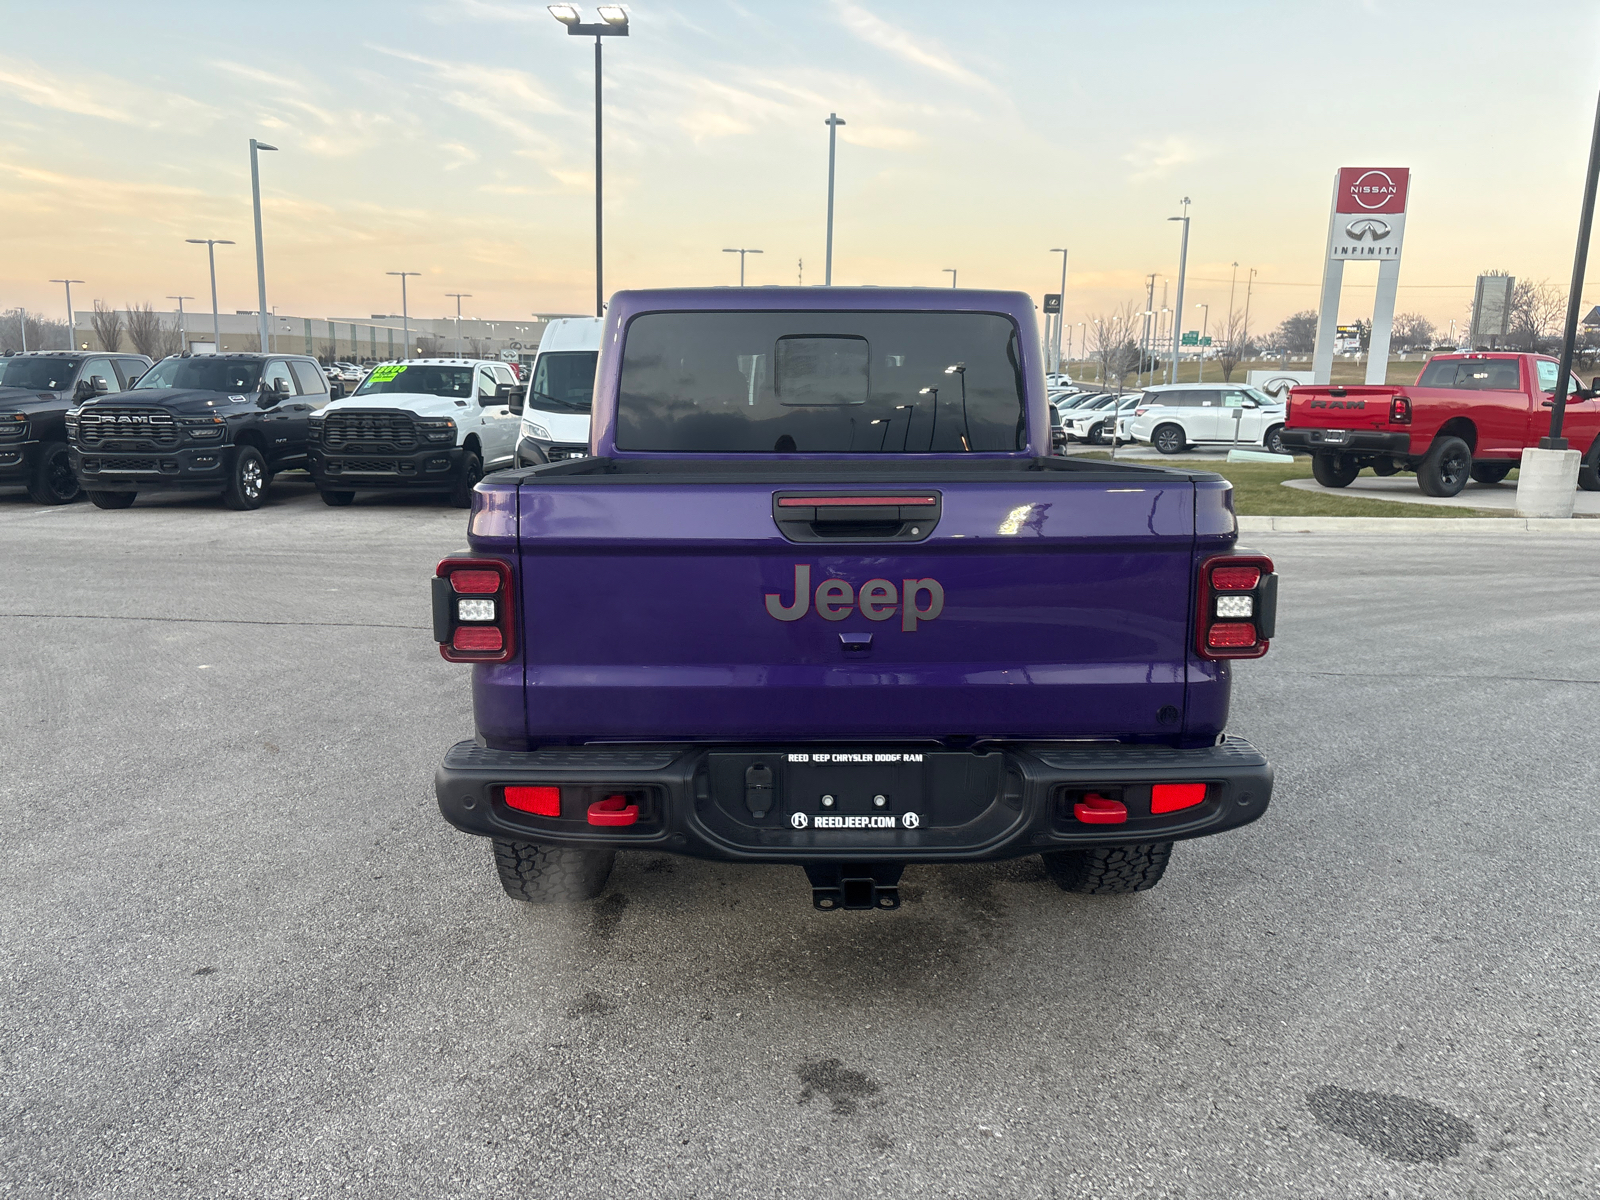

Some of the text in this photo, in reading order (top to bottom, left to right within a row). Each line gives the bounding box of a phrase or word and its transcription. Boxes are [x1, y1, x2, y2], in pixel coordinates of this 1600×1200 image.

[1350, 186, 1397, 194] NISSAN
[1334, 246, 1398, 255] INFINITI
[1310, 401, 1366, 410] RAM
[101, 416, 148, 424] RAM
[765, 564, 945, 632] Jeep
[788, 753, 809, 762] REED
[832, 753, 873, 762] CHRYSLER
[875, 753, 902, 762] DODGE
[903, 754, 923, 762] RAM
[815, 816, 896, 828] REEDJEEP.COM
